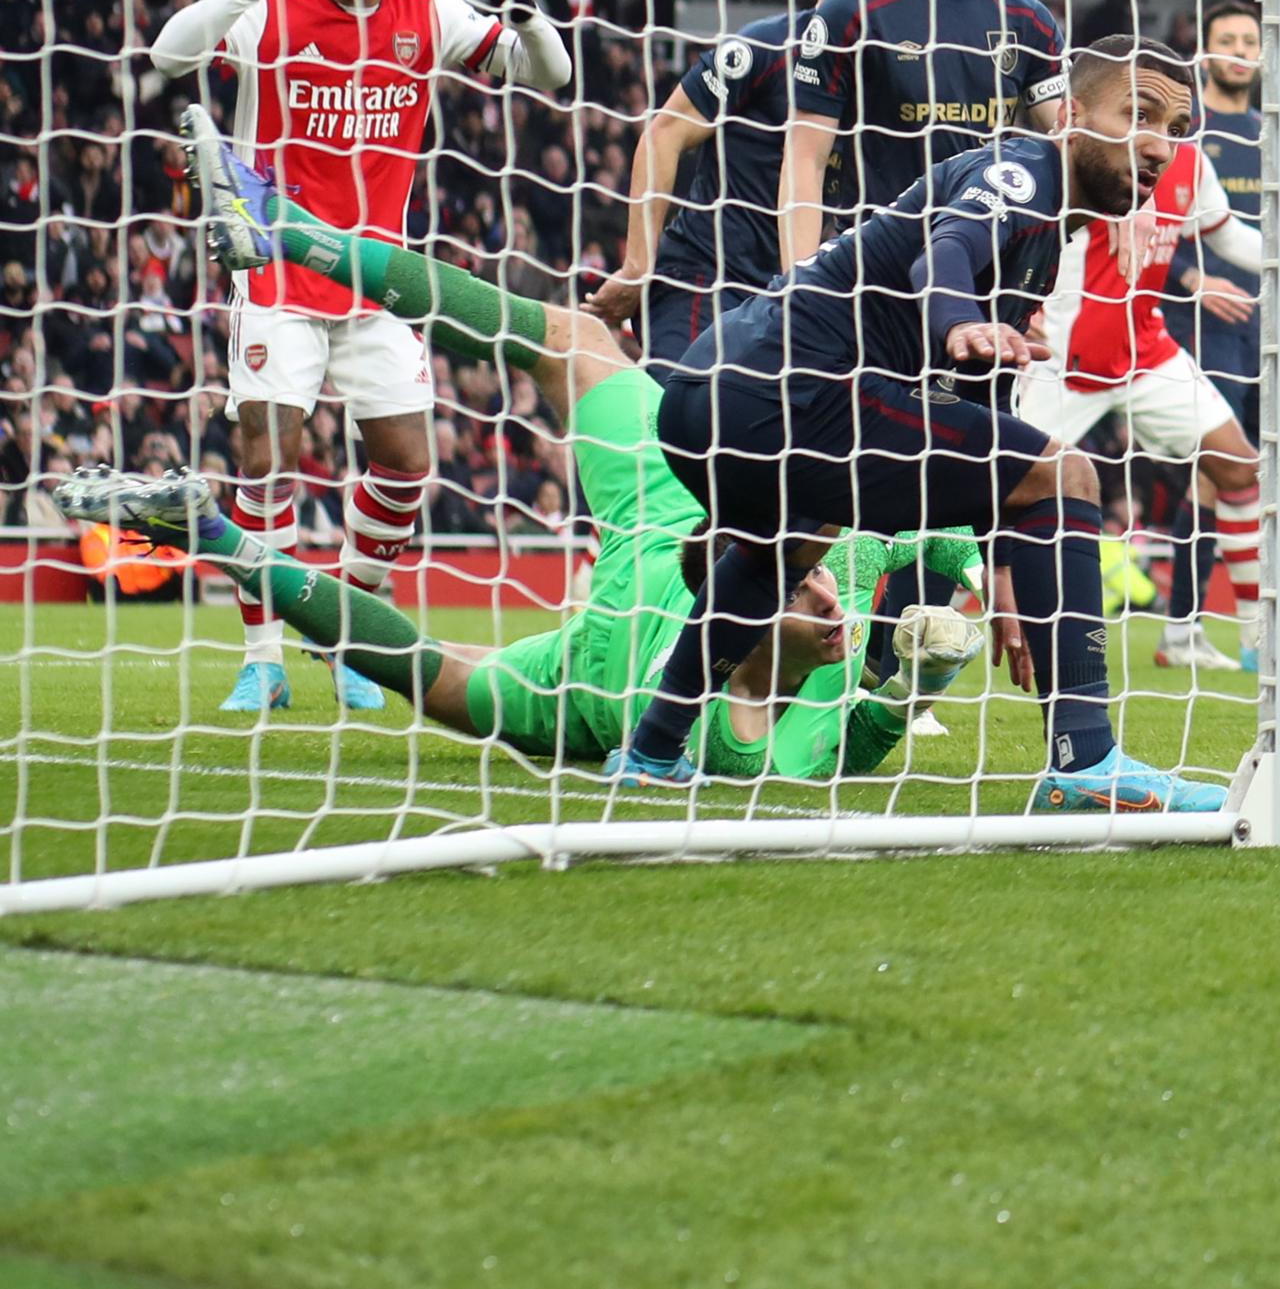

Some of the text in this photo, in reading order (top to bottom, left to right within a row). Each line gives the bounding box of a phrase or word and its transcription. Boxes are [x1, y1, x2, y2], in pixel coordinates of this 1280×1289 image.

[288, 78, 419, 110] Emirates
[306, 112, 400, 140] FLY BETTER
